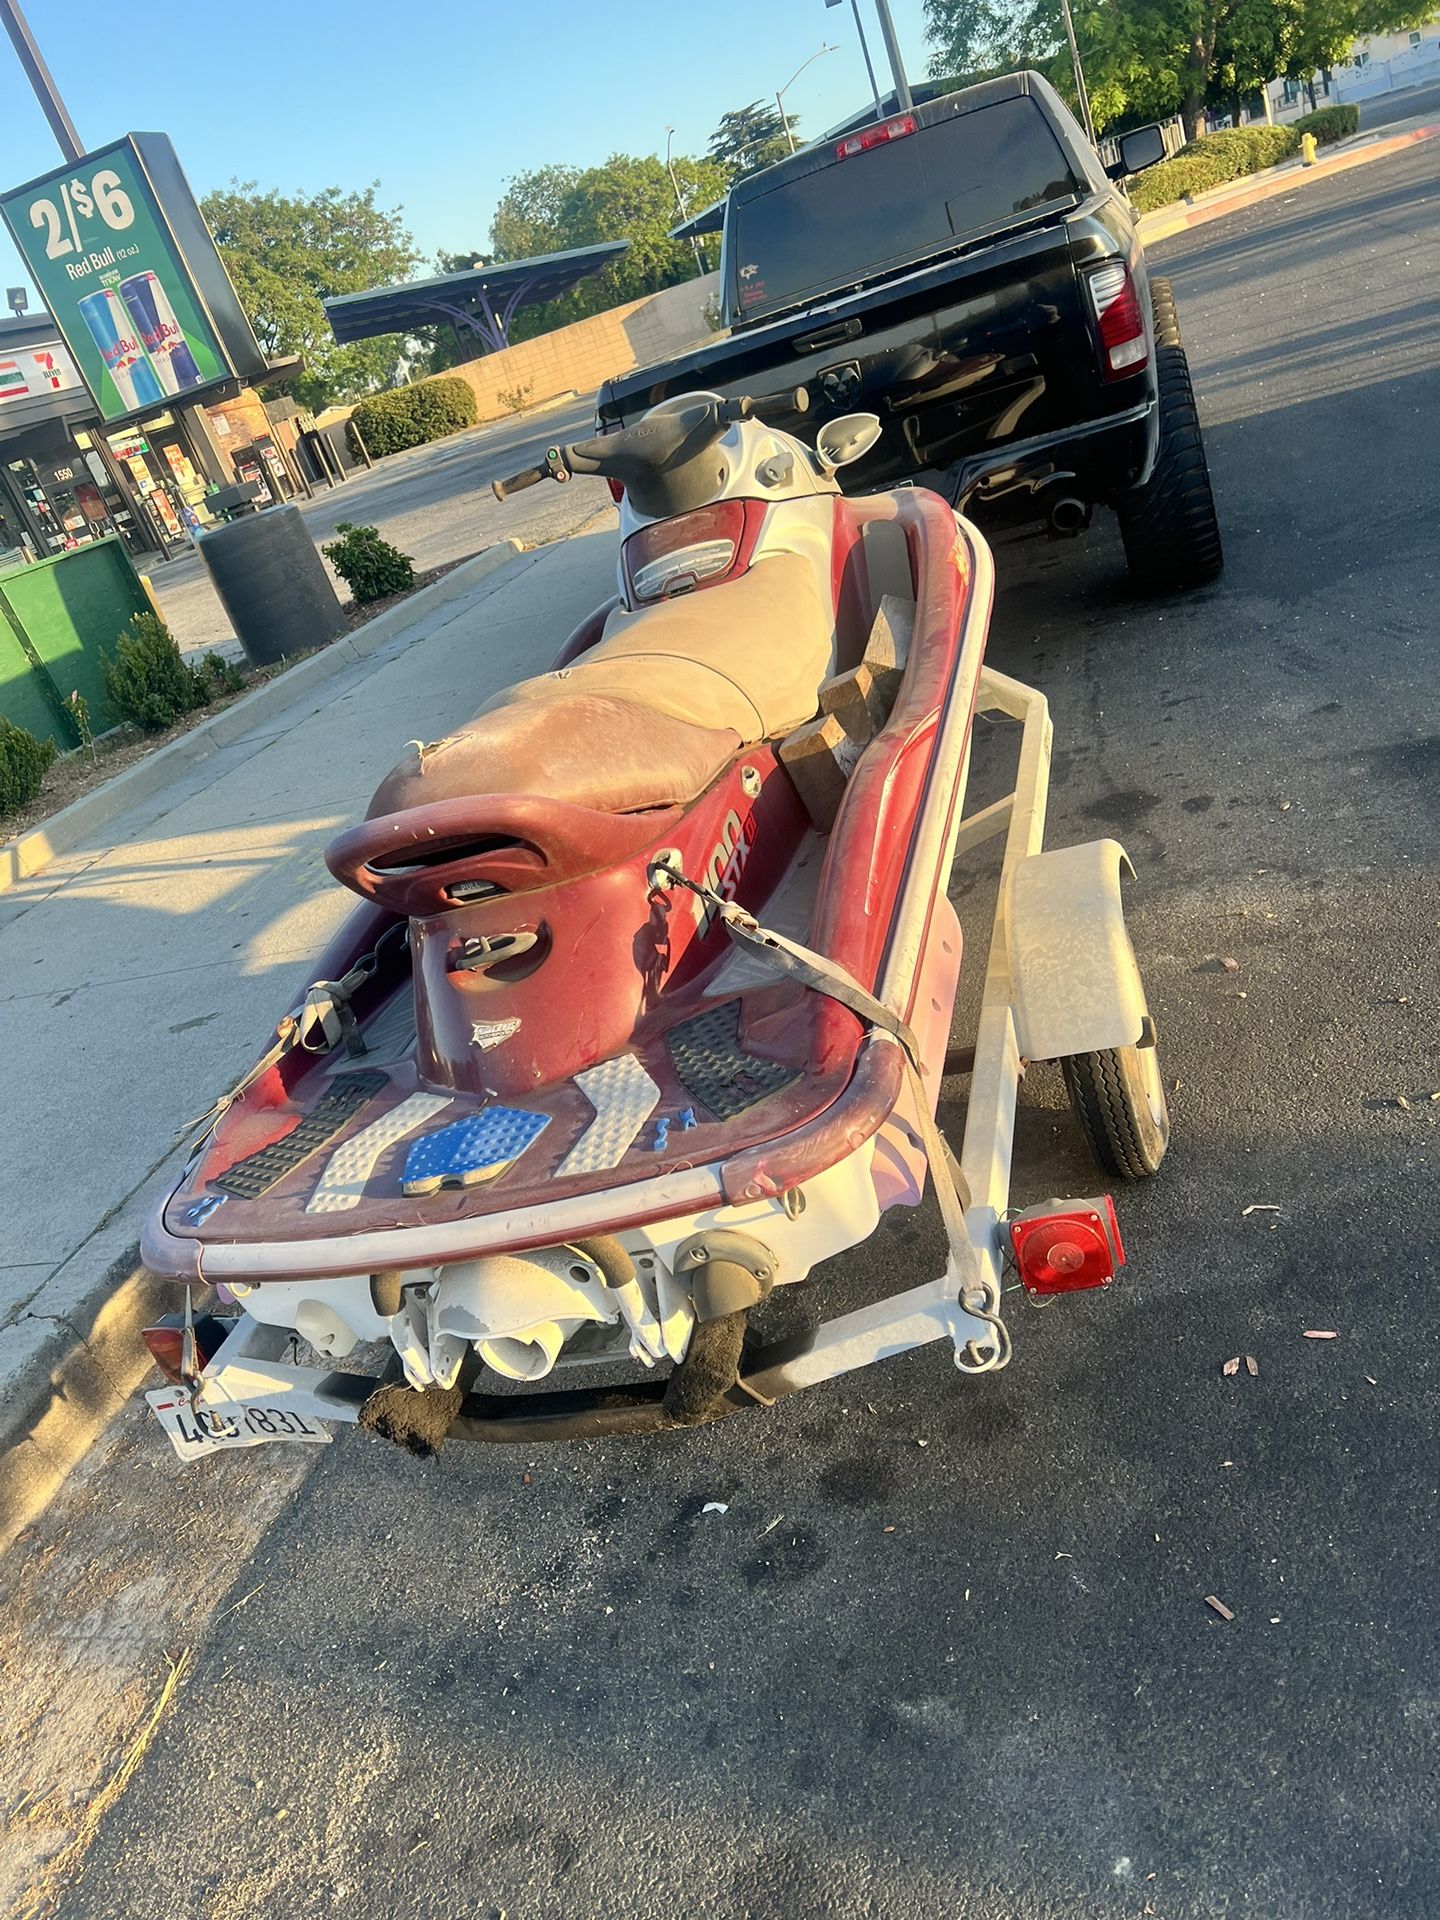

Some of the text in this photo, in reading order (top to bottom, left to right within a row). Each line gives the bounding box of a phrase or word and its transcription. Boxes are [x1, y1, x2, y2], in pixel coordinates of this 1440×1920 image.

[65, 257, 92, 280] Red
[89, 246, 116, 270] Bull
[53, 467, 74, 481] 1550
[721, 830, 751, 901] STX
[460, 881, 481, 892] PULL
